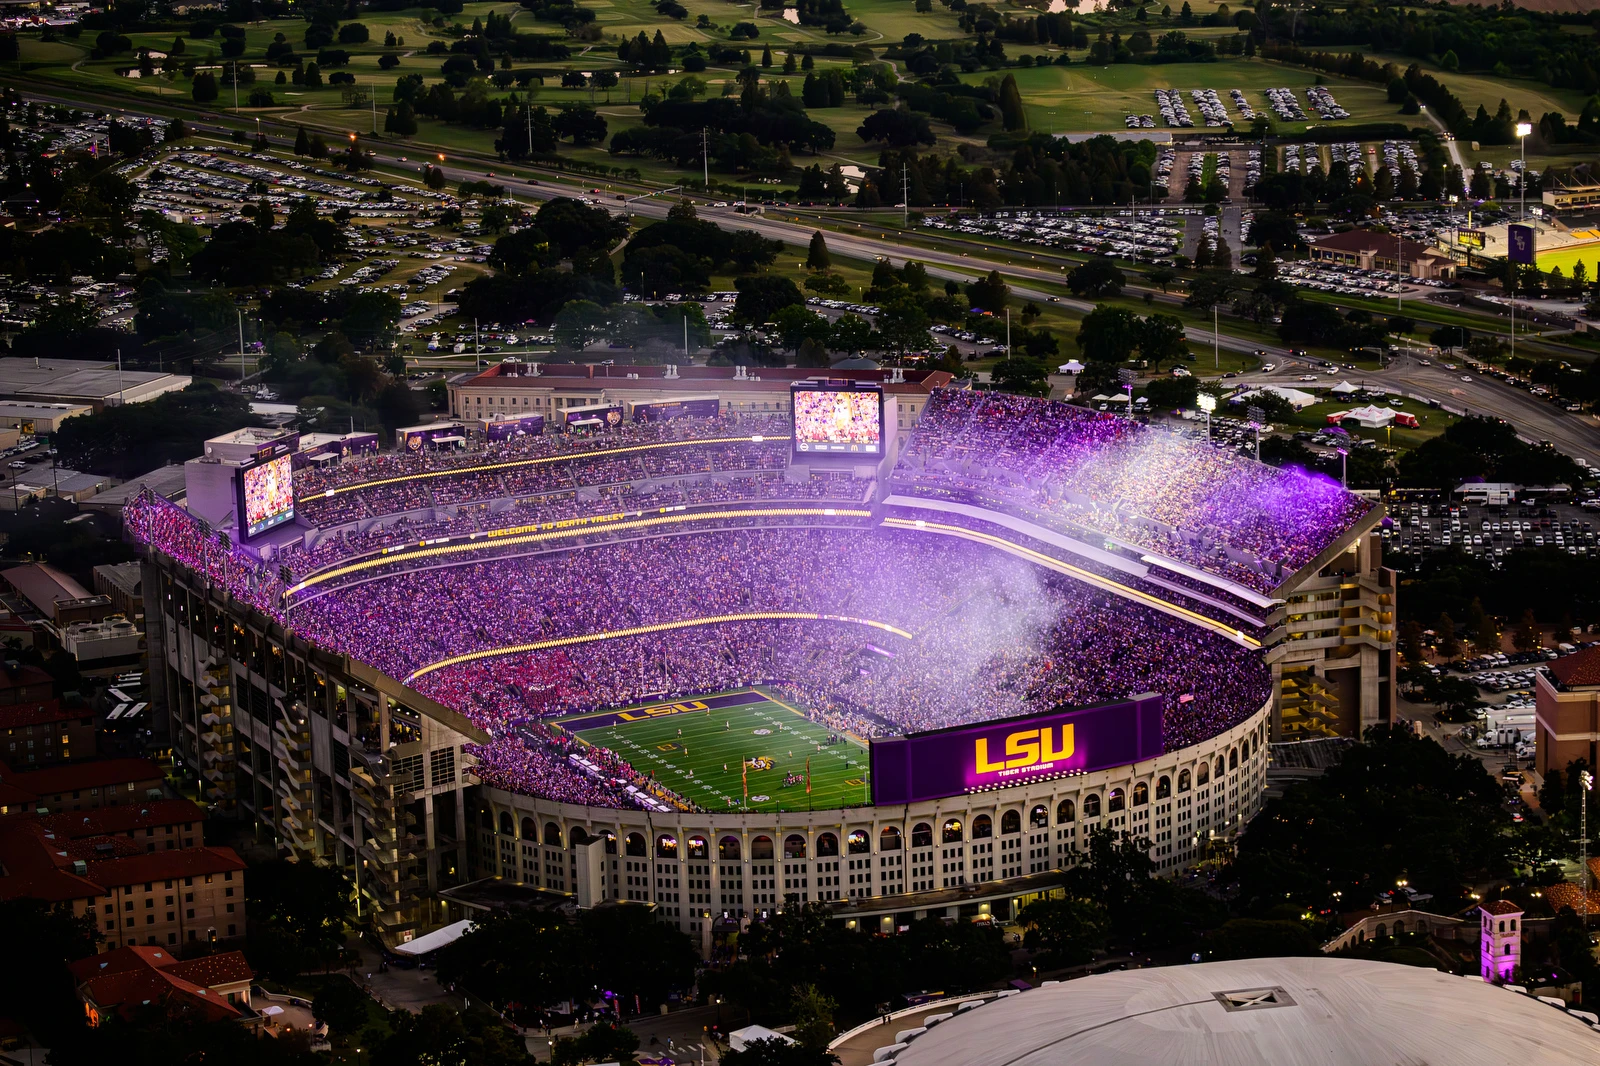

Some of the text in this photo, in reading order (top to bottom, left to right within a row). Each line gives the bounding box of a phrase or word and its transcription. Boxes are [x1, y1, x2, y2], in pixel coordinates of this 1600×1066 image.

[1514, 231, 1526, 251] LSU
[488, 525, 537, 538] WELCOME
[556, 519, 587, 528] DEATH
[591, 513, 625, 524] VALLEY
[617, 701, 710, 721] LSU
[975, 723, 1075, 774] LSU
[998, 763, 1053, 776] TIGER STADIUM
